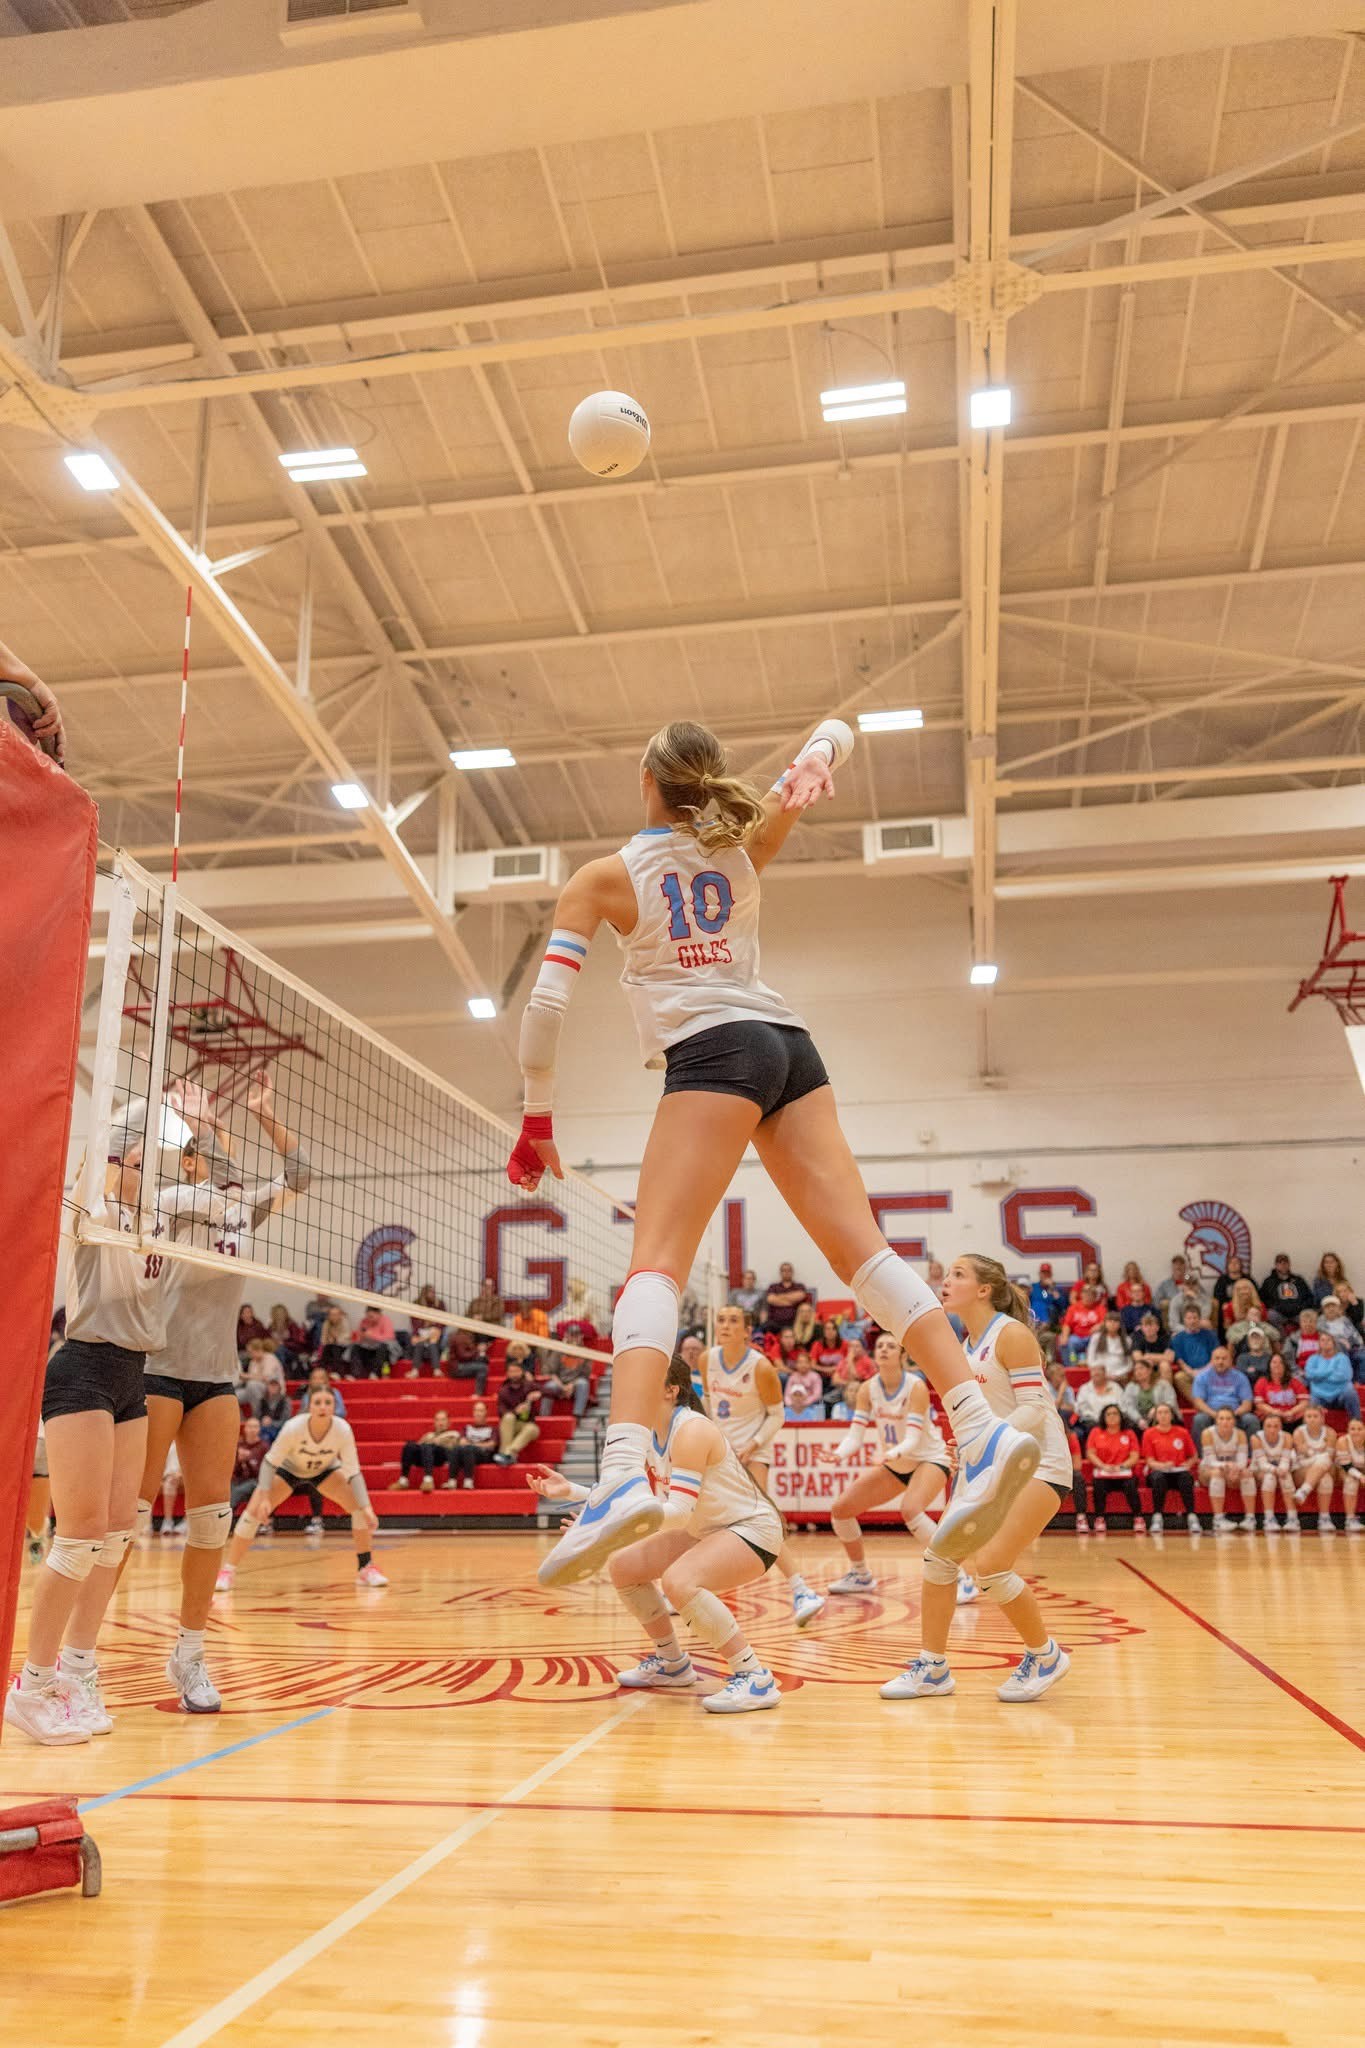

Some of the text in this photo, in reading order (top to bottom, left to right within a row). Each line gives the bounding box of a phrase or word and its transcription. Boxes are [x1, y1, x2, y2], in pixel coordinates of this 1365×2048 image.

[660, 870, 736, 941] 10
[677, 938, 733, 968] GILES
[482, 1185, 1102, 1316] GLES
[717, 1400, 731, 1419] 8
[884, 1423, 899, 1446] 11
[775, 1472, 860, 1498] SPART
